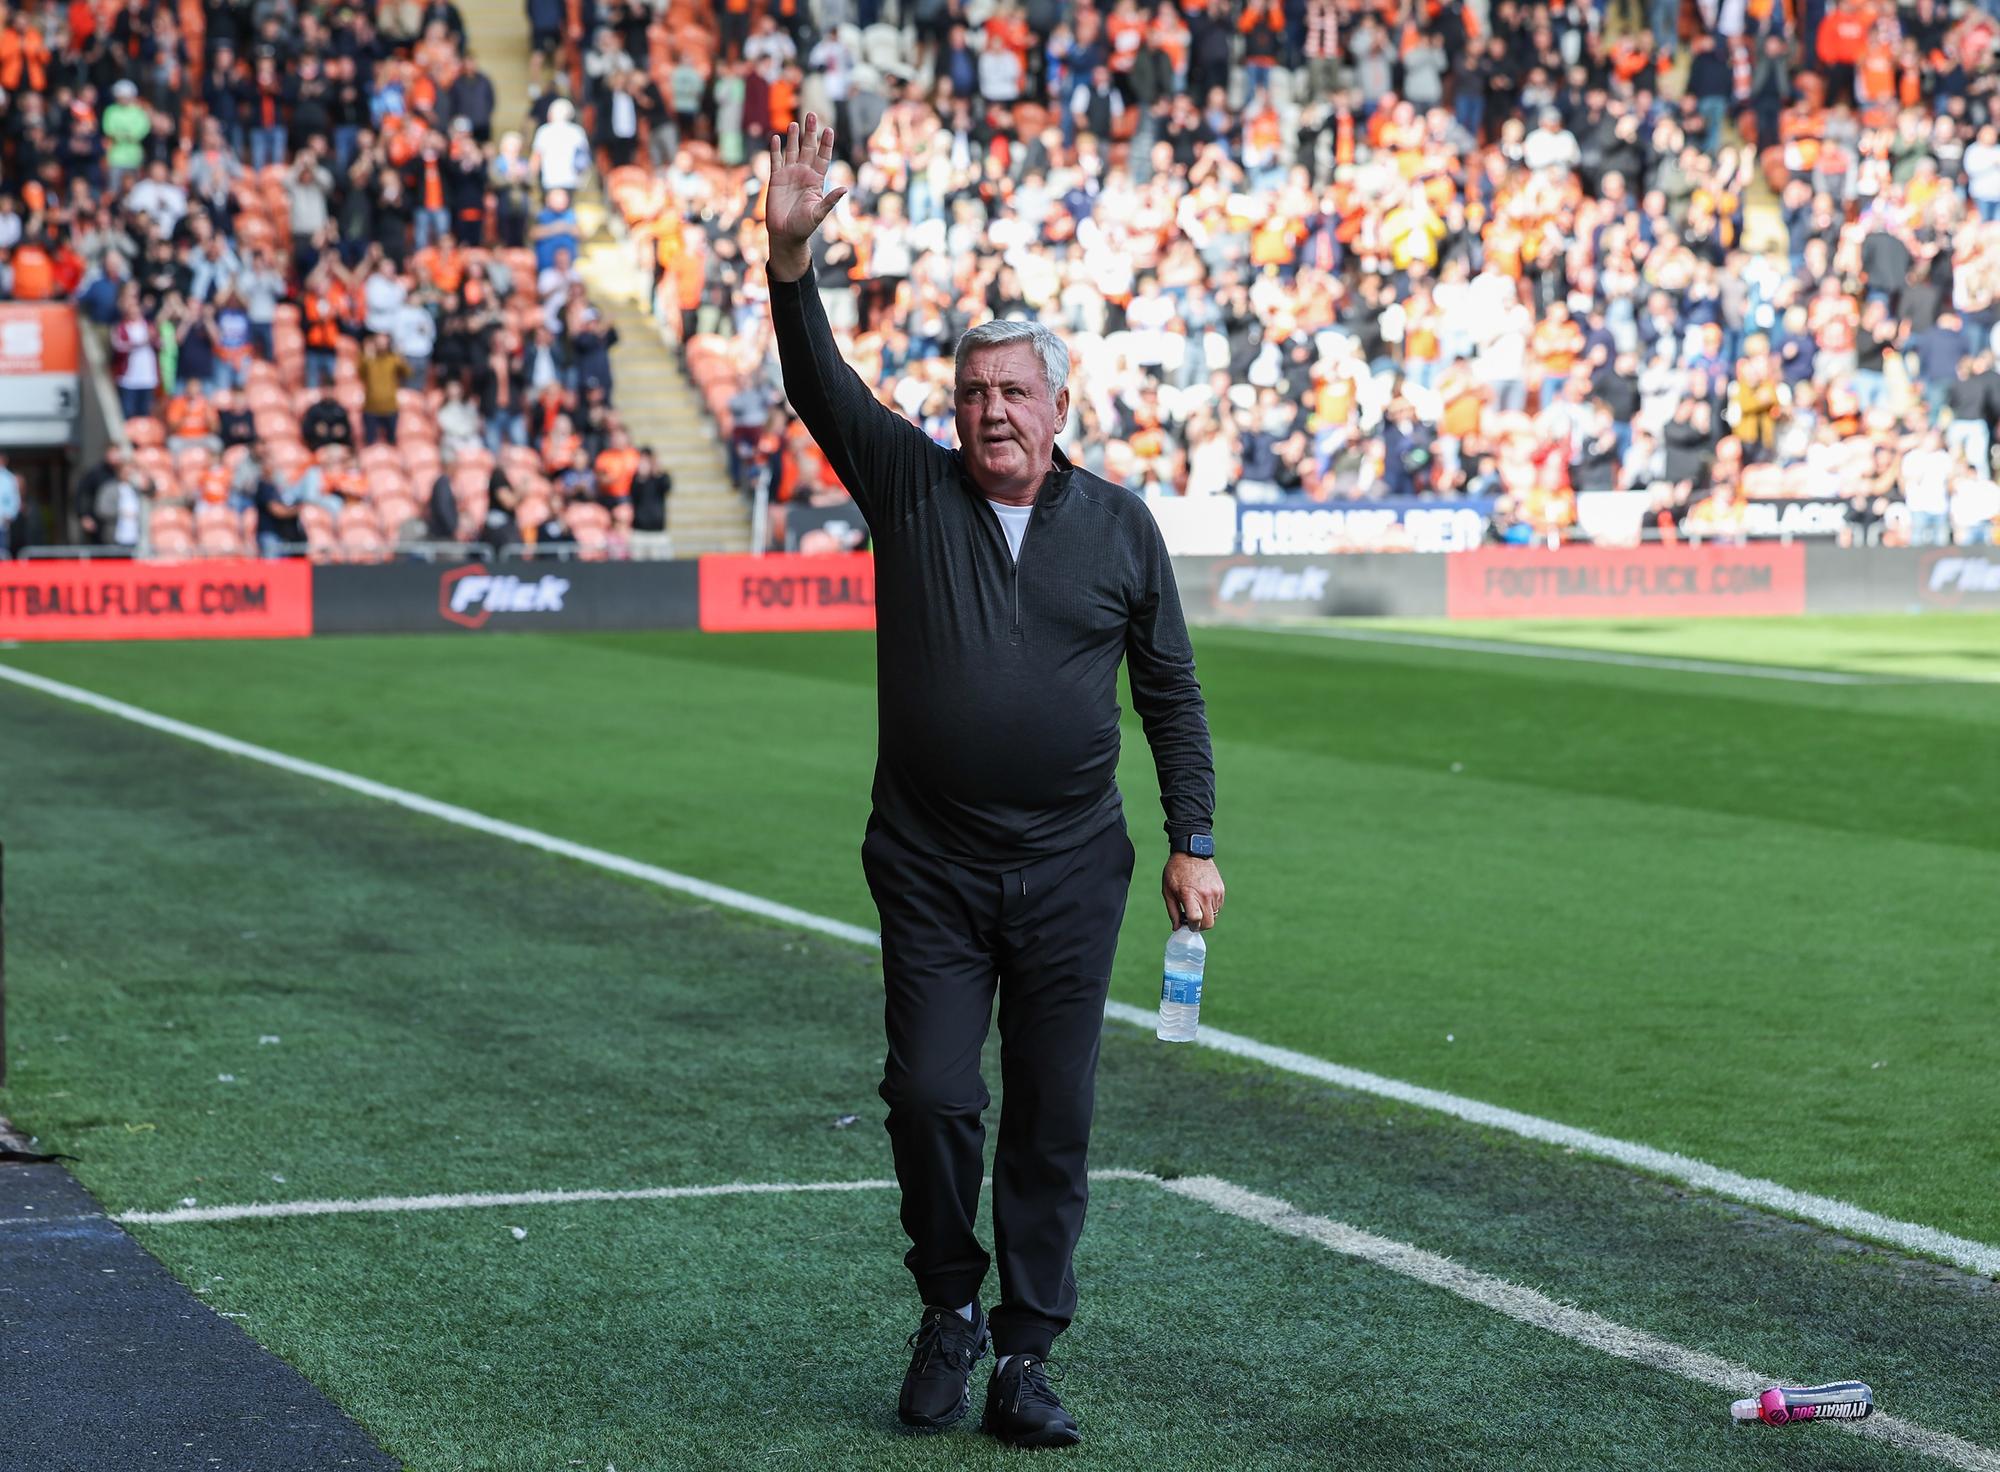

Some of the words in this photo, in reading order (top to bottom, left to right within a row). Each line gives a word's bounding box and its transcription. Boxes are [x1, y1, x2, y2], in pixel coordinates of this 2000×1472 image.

[0, 584, 267, 615] TBALLFLICK.COM
[450, 574, 570, 612] Flick
[743, 575, 875, 607] FOOTBAL
[1217, 566, 1330, 600] Flick
